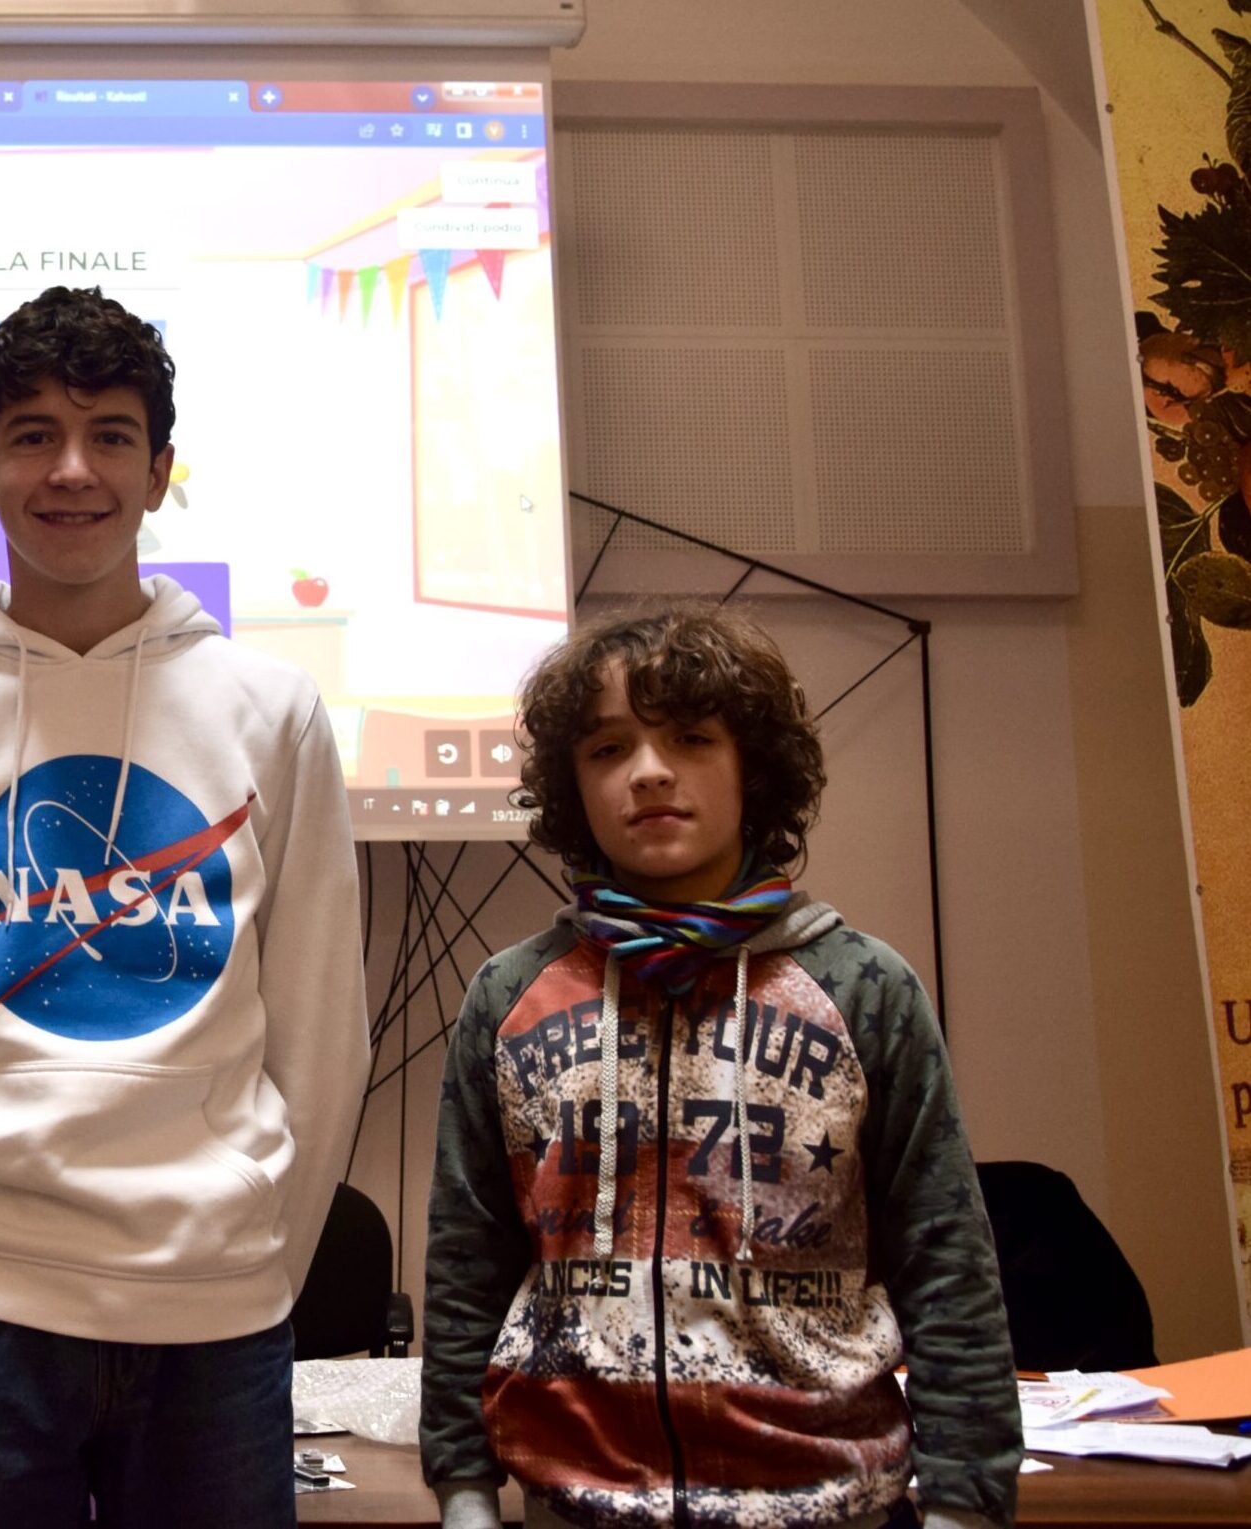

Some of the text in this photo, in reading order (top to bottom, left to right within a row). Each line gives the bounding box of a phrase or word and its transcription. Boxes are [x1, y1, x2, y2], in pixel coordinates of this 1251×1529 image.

[40, 251, 147, 271] FINALE
[690, 1260, 732, 1300] IN
[739, 1266, 844, 1309] LIFE!!!
